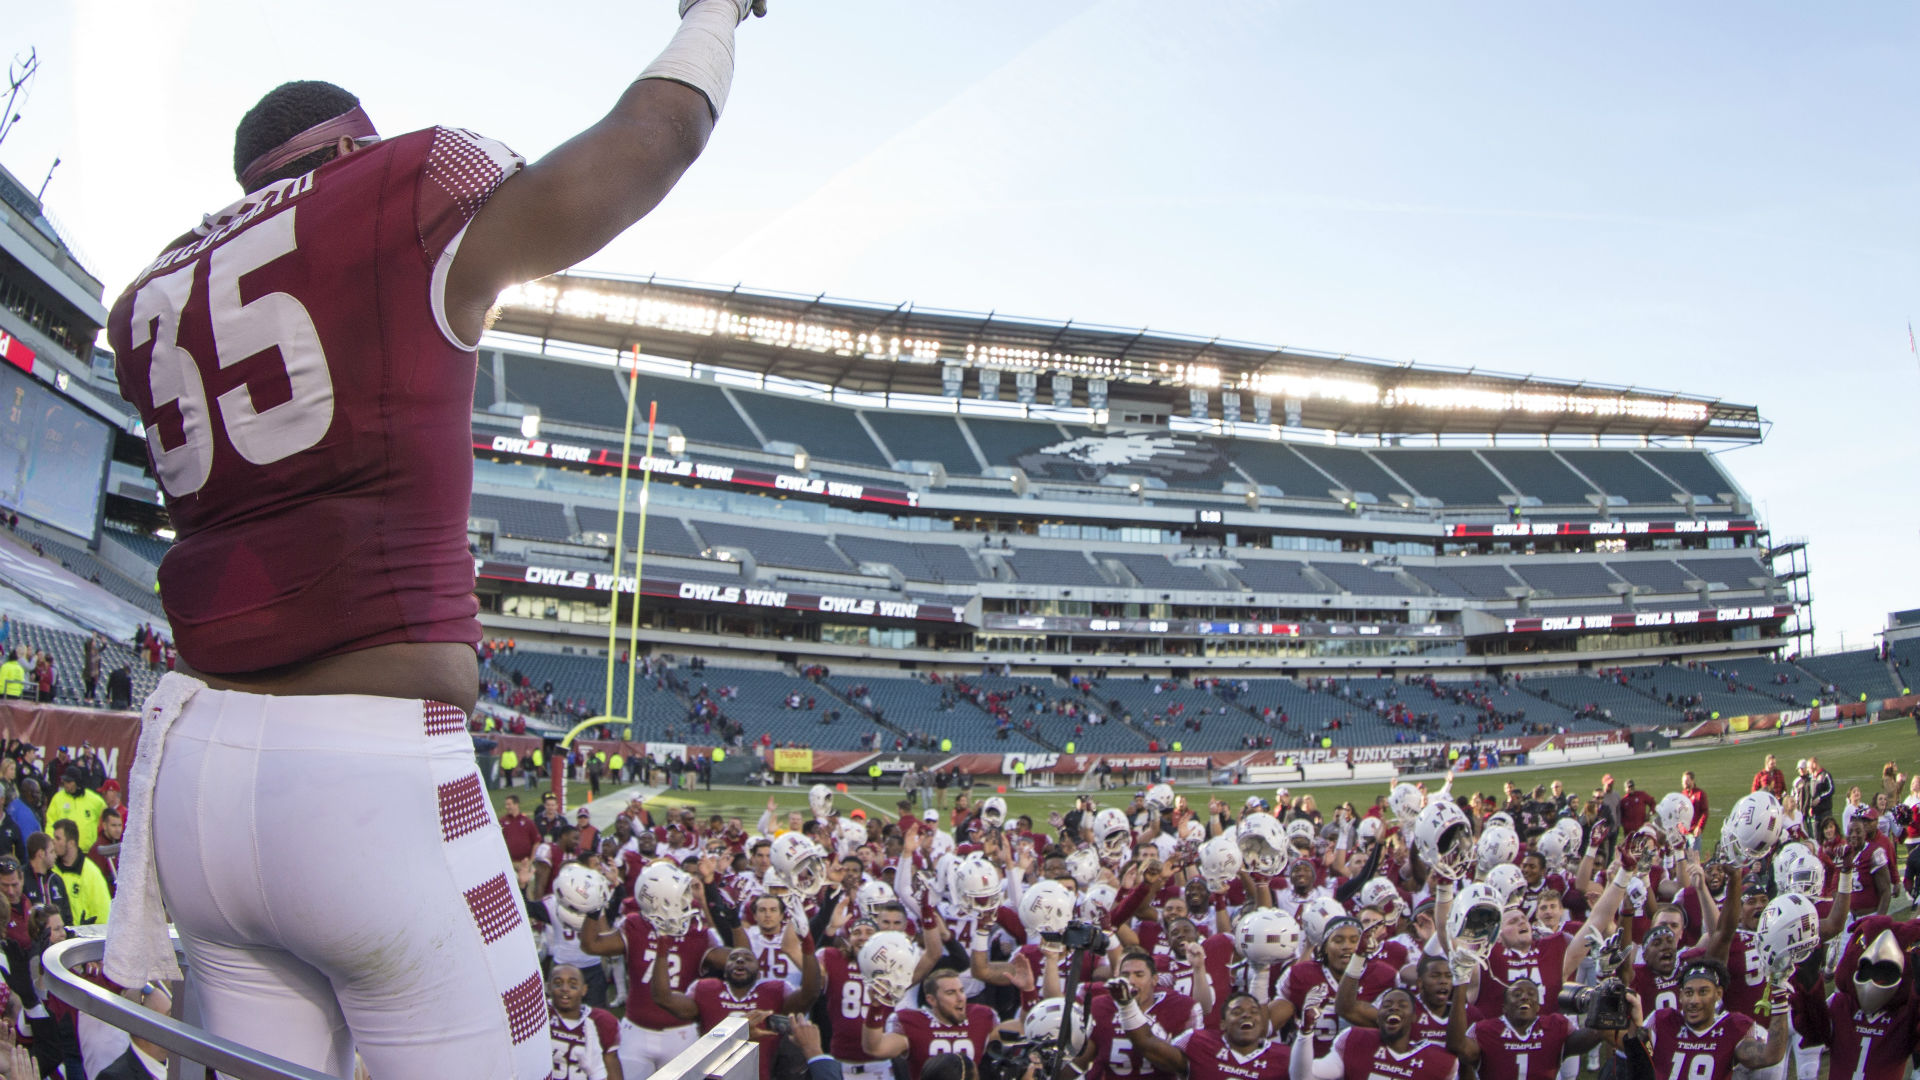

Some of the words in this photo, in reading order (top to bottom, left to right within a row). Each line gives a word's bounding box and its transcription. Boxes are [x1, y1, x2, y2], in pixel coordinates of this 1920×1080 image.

[131, 207, 334, 499] 35
[492, 436, 548, 457] OWLS
[551, 443, 591, 463] WIN!
[639, 456, 693, 476] OWLS
[696, 463, 734, 482] WIN!
[775, 474, 825, 494] OWLS
[828, 481, 863, 499] WIN!
[1493, 522, 1531, 537] OWLS
[1589, 521, 1624, 534] OWLS
[1625, 521, 1649, 533] WIN!
[1675, 521, 1706, 533] OWLS
[1707, 520, 1729, 532] WIN!
[525, 566, 589, 589] OWLS
[679, 582, 740, 604] OWLS
[745, 589, 787, 607] WIN!
[819, 596, 875, 615] OWLS
[879, 600, 918, 618] WIN!
[1717, 608, 1750, 621] OWLS
[1752, 606, 1775, 619] WIN!
[1542, 616, 1584, 631] OWLS
[1584, 615, 1613, 629] WIN!
[1635, 612, 1672, 626] OWLS
[1673, 610, 1700, 624] WIN!
[1274, 747, 1348, 765] TEMPLE
[1352, 743, 1445, 762] UNIVERSITY
[1002, 753, 1060, 774] OWLS
[1107, 756, 1208, 768] OWLSPOTS.COM
[758, 948, 788, 978] 45
[721, 1002, 757, 1010] TEMPLE
[1856, 1026, 1884, 1036] TEMPLE
[1678, 1041, 1717, 1050] TEMPLE
[1852, 1036, 1872, 1080] 1
[1218, 1064, 1259, 1079] TEMPLE
[1374, 1062, 1413, 1077] TEMPLE
